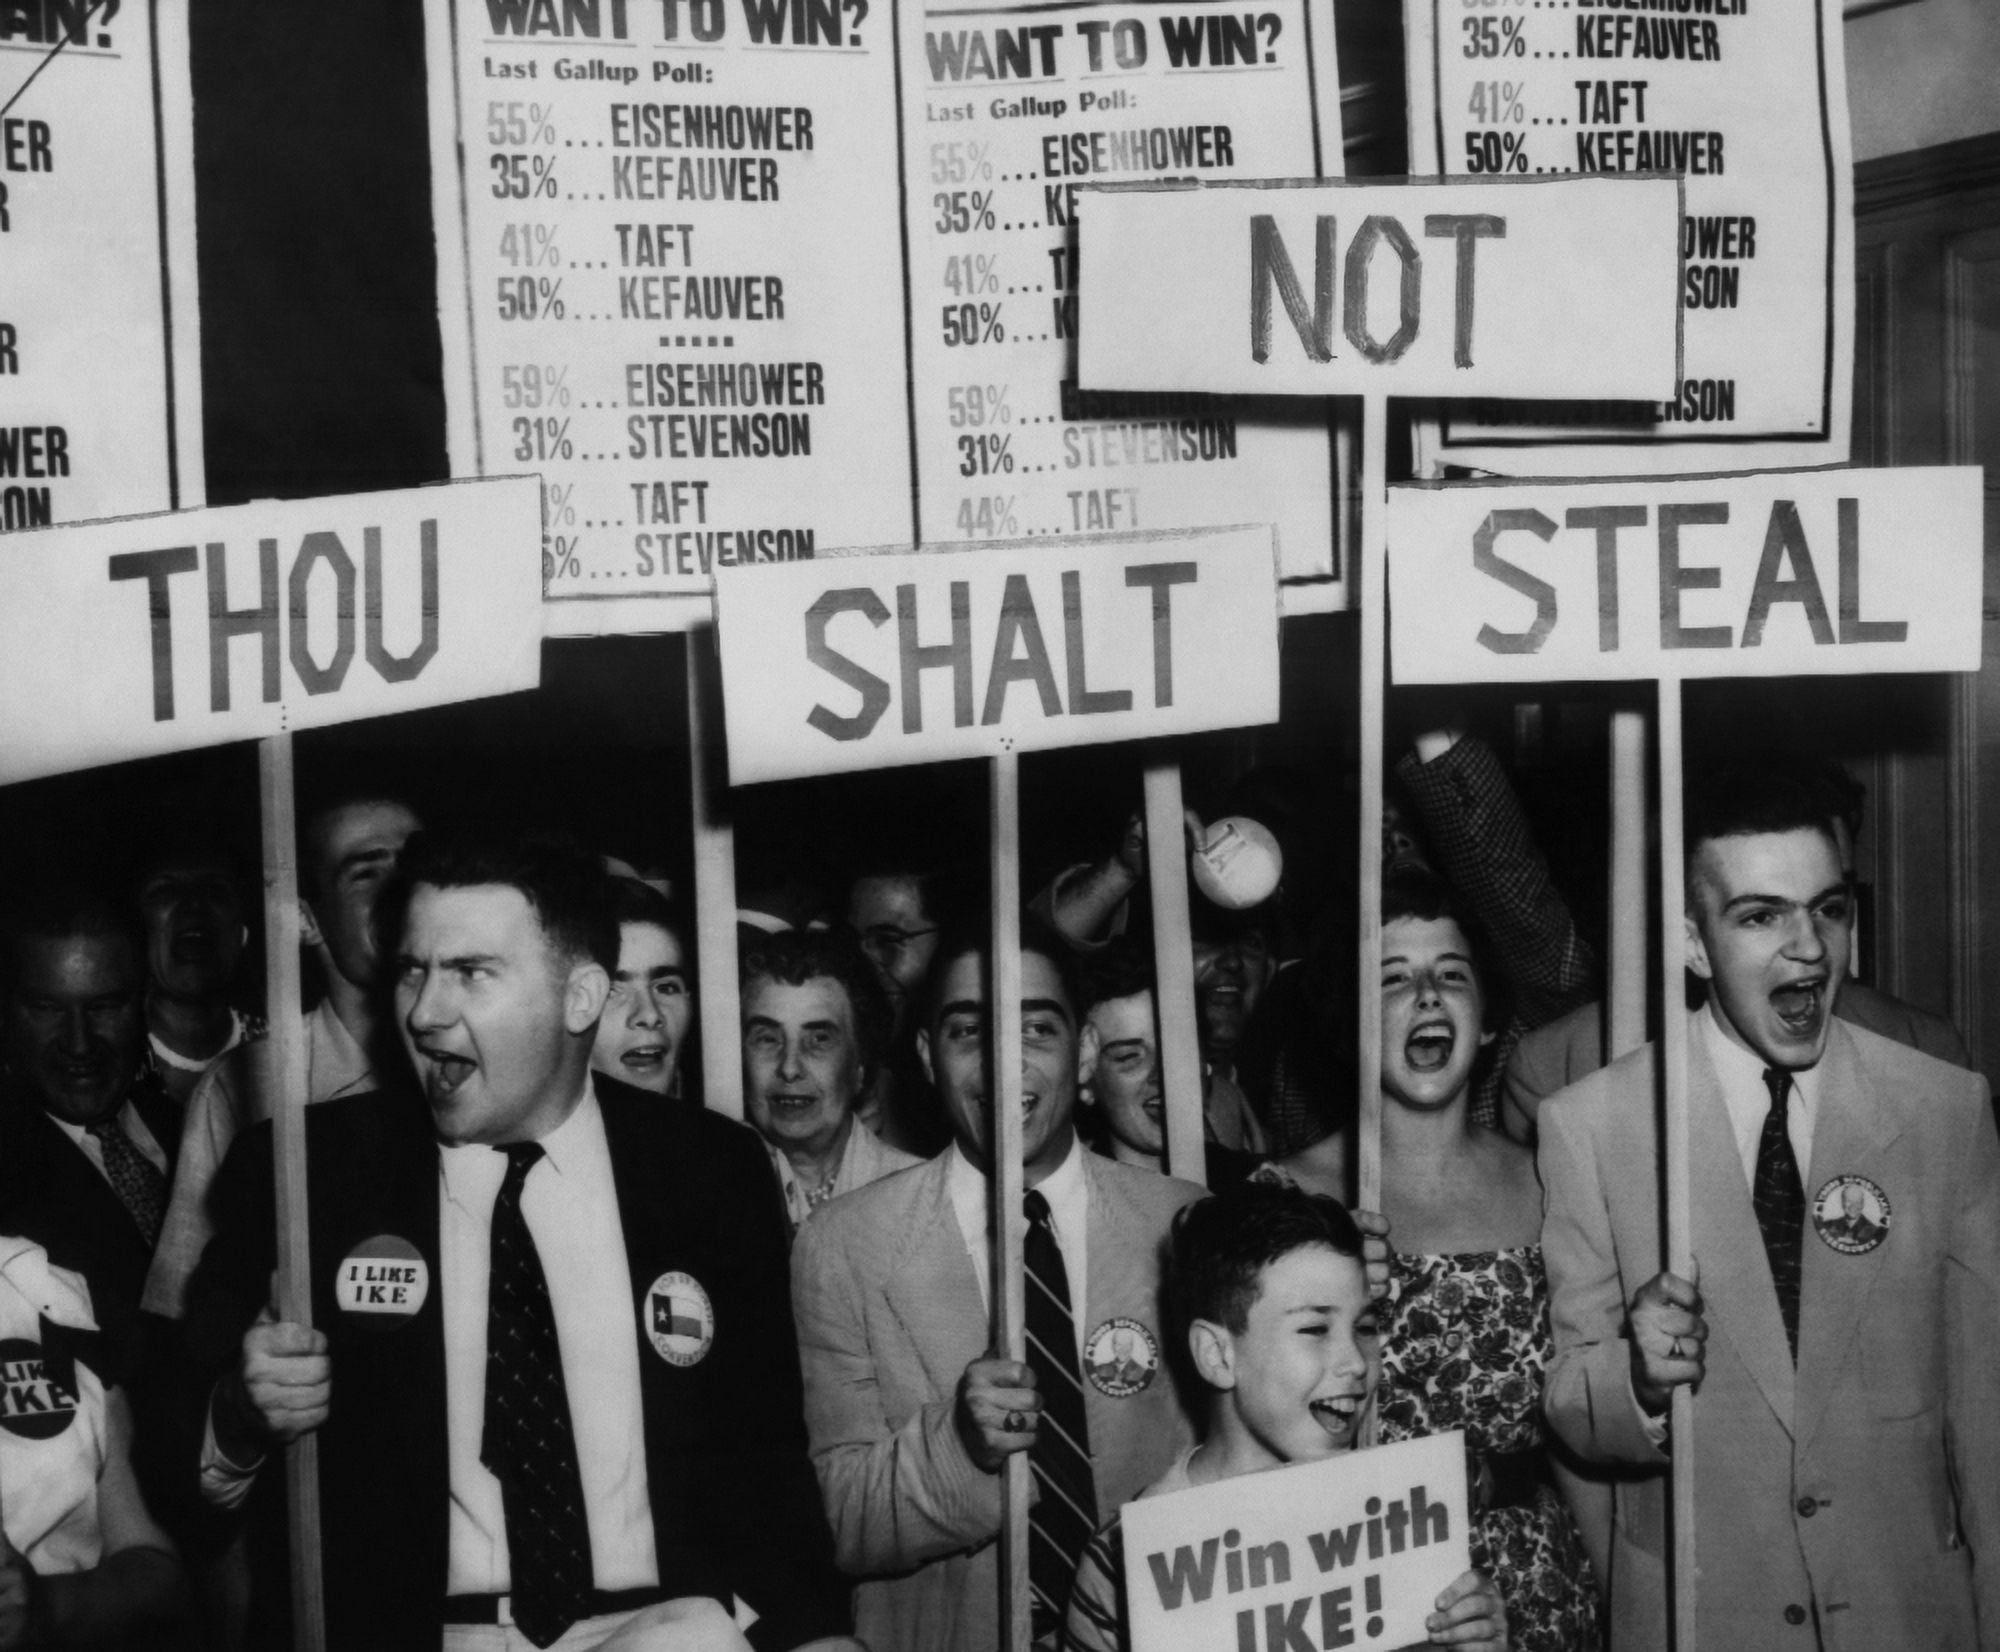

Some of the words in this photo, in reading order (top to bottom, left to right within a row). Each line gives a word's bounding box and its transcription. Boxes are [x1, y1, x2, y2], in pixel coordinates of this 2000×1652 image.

[484, 0, 632, 40] WANT
[656, 0, 726, 43] TO
[740, 0, 872, 48] WIN?
[926, 24, 1064, 81] WANT
[1075, 18, 1148, 72] TO
[1158, 12, 1283, 68] WIN?
[1462, 15, 1527, 59] 35%
[1575, 13, 1722, 62] KEFAUVER
[483, 56, 538, 79] Last
[553, 57, 640, 86] Gallup
[652, 60, 713, 84] Poll:
[486, 100, 556, 147] 55%
[610, 102, 814, 152] EISENHOWER
[926, 102, 975, 123] Last
[989, 96, 1068, 120] Gallup
[1078, 90, 1136, 113] Poll:
[1467, 80, 1525, 125] 41%
[1574, 79, 1649, 125] TAFT
[489, 152, 558, 200] 35%
[613, 155, 780, 203] KEFAUVER
[929, 140, 994, 186] 55%
[1041, 125, 1235, 178] EISENHOWER
[1462, 129, 1531, 176] 50%
[1574, 129, 1726, 177] KEFAUVER
[933, 189, 997, 235] 35%
[498, 222, 561, 268] 41%
[614, 223, 695, 268] TAFT
[497, 275, 565, 322] 50%
[619, 275, 785, 321] KEFAUVER
[943, 253, 1000, 297] 41%
[1249, 213, 1507, 370] NOT
[942, 301, 1005, 348] 50%
[502, 363, 571, 410] 59%
[626, 361, 825, 408] EISENHOWER
[947, 383, 1011, 429] 59%
[512, 415, 574, 462] 31%
[628, 411, 812, 459] STEVENSON
[957, 433, 1014, 478] 31%
[1062, 420, 1238, 470] STEVENSON
[630, 480, 710, 524] TAFT
[956, 495, 1018, 539] 44%
[1066, 487, 1142, 534] TAFT
[634, 528, 815, 577] STEVENSON
[1472, 497, 1909, 655] STEAL
[107, 515, 441, 725] THOU
[803, 561, 1198, 743] SHALT
[355, 1285, 407, 1305] IKE
[365, 1265, 417, 1284] LIKE
[1146, 1527, 1294, 1614] Win
[1306, 1484, 1450, 1574] with
[1235, 1572, 1386, 1652] IKE!
